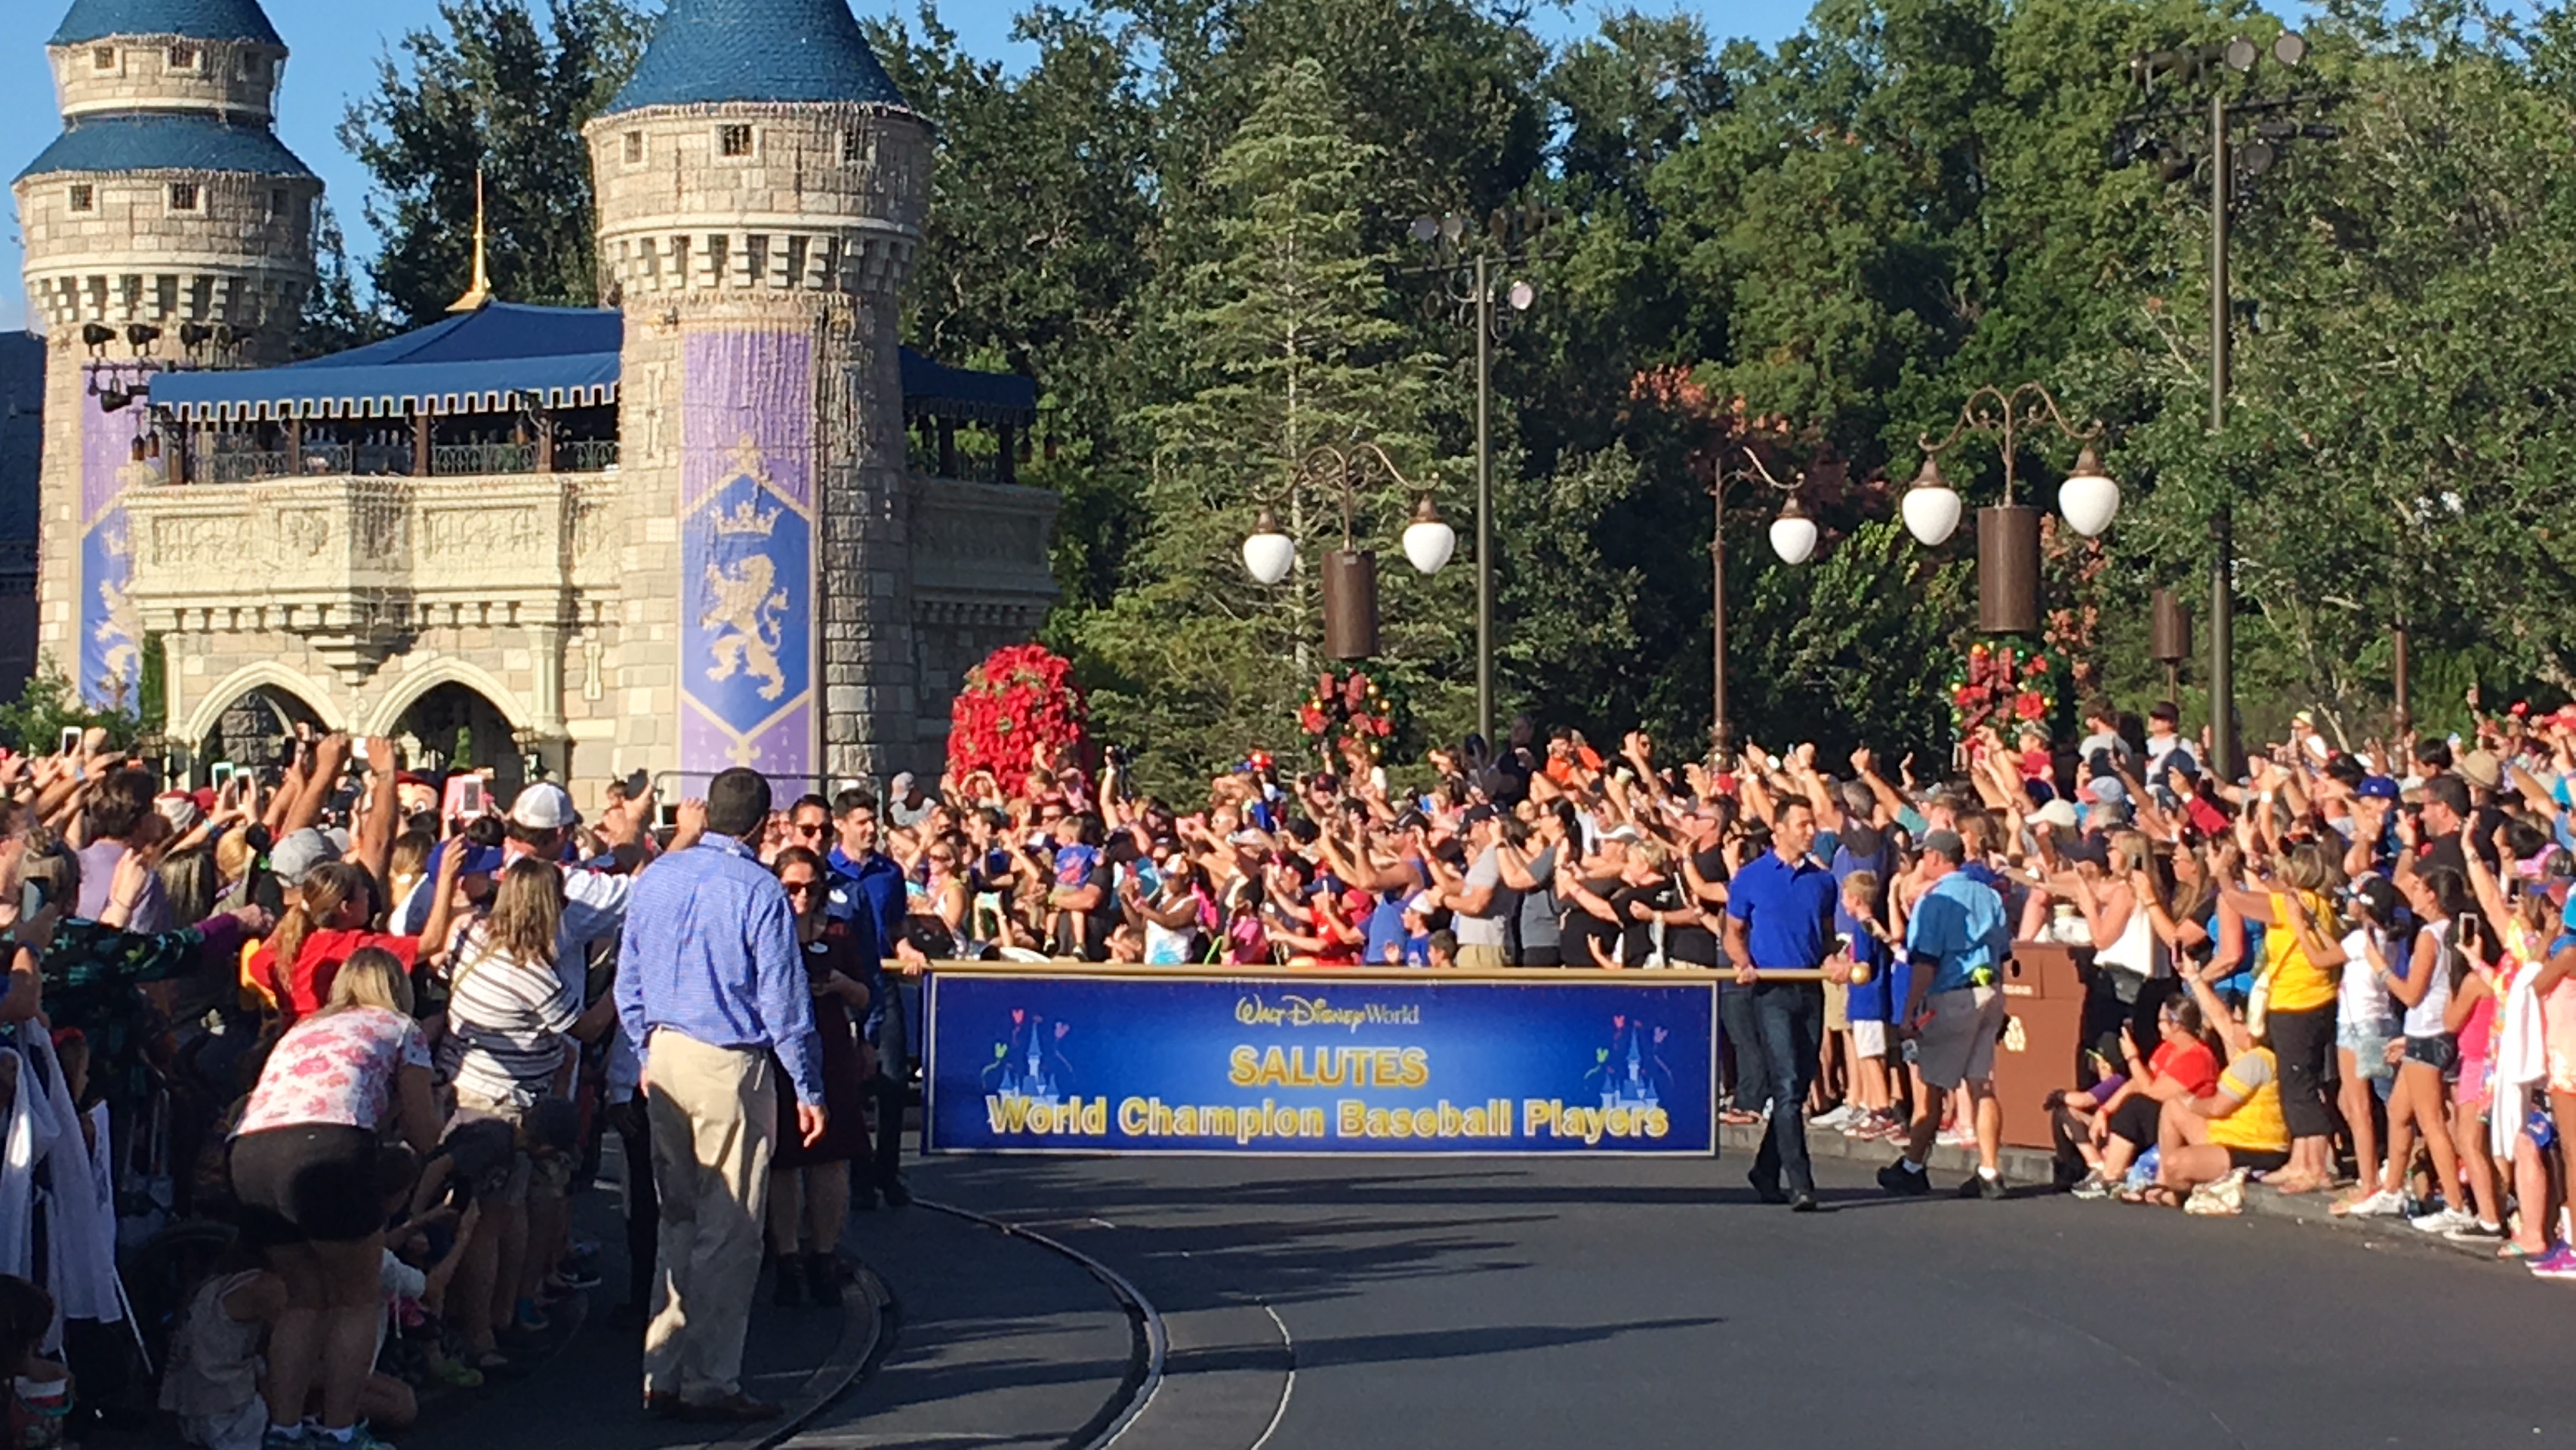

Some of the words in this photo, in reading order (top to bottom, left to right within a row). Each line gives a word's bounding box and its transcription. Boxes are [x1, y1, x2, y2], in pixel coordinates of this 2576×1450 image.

[1281, 995, 1365, 1034] Disney
[1364, 1003, 1419, 1024] World
[1228, 1044, 1429, 1088] SALUTES
[985, 1094, 1108, 1135] World
[1117, 1097, 1326, 1144] Champion
[1336, 1098, 1512, 1138] Baseball
[1522, 1098, 1669, 1144] Players
